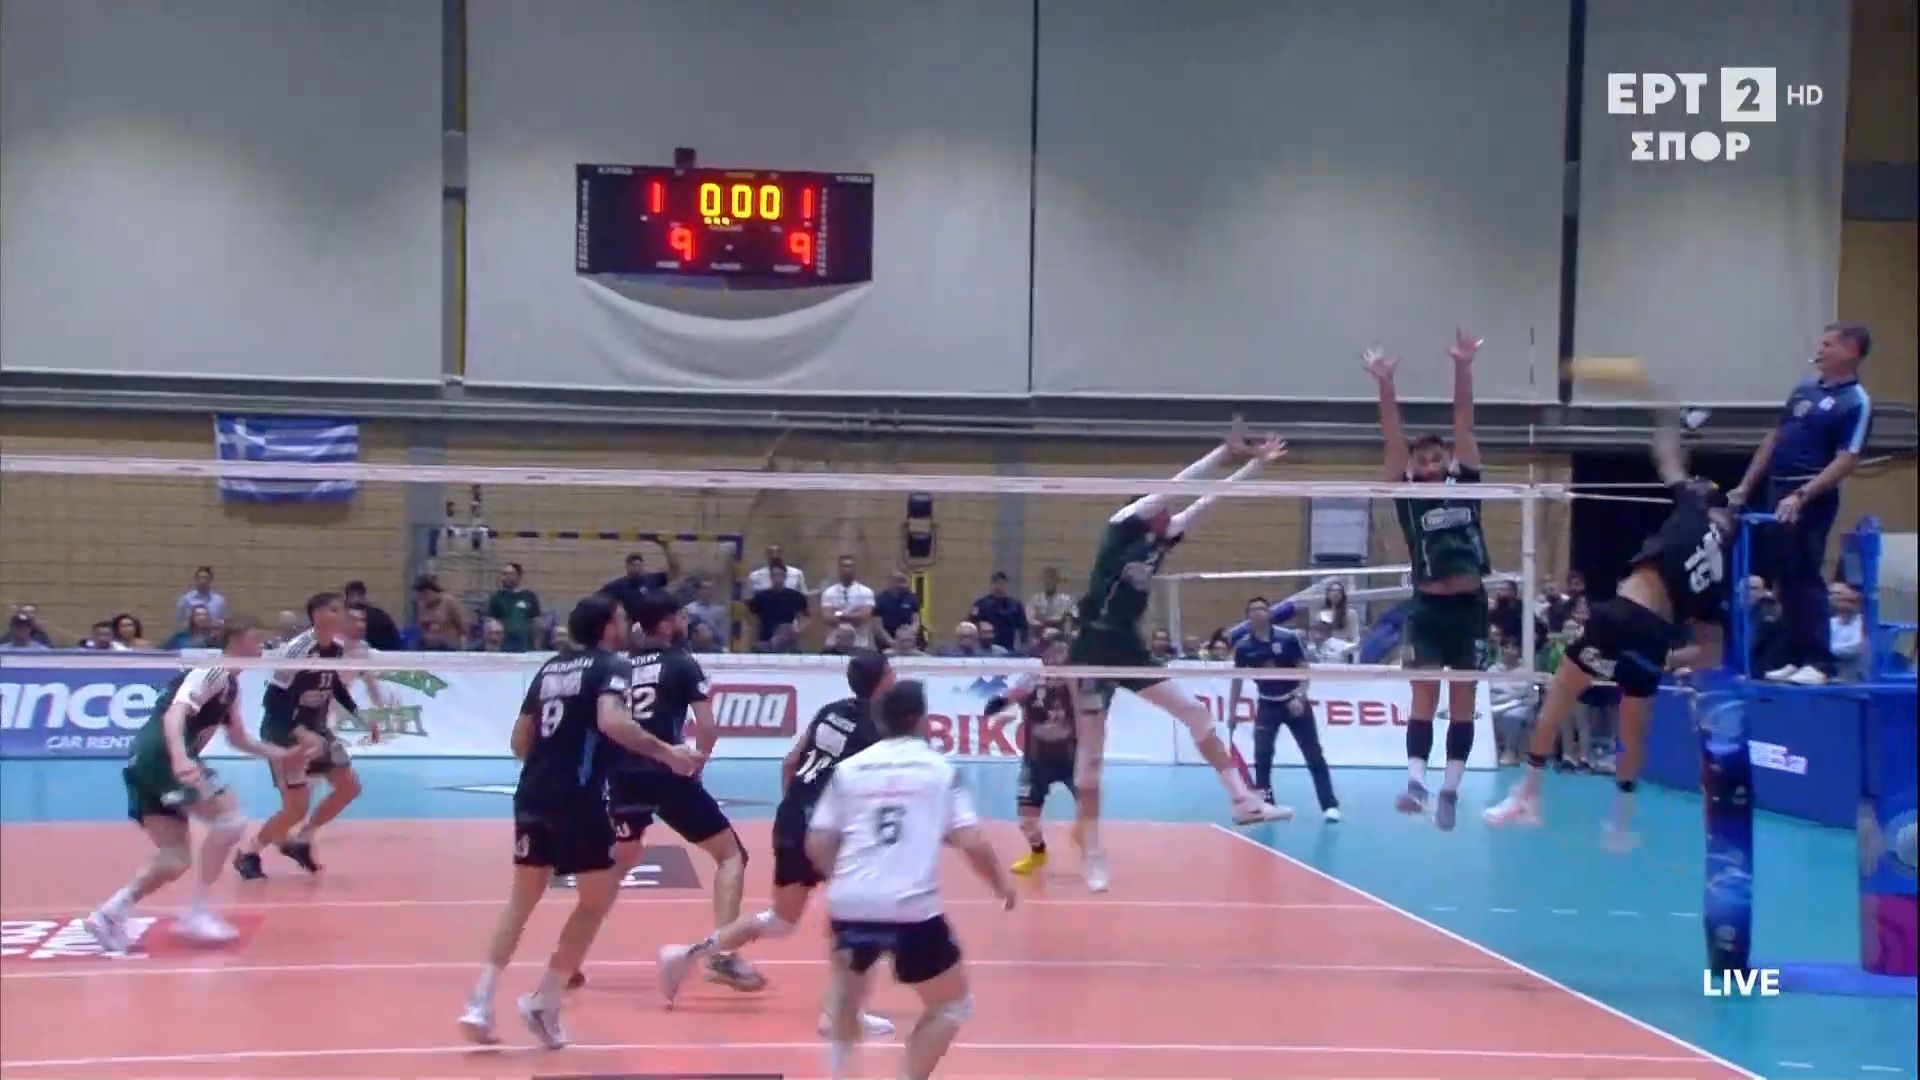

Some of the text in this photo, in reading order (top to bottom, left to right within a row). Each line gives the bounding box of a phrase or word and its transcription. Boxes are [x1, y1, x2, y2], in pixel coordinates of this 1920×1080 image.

[652, 181, 662, 214] 1
[803, 187, 812, 219] 1
[671, 227, 693, 262] 9
[790, 232, 811, 265] 9
[46, 735, 82, 750] CAR
